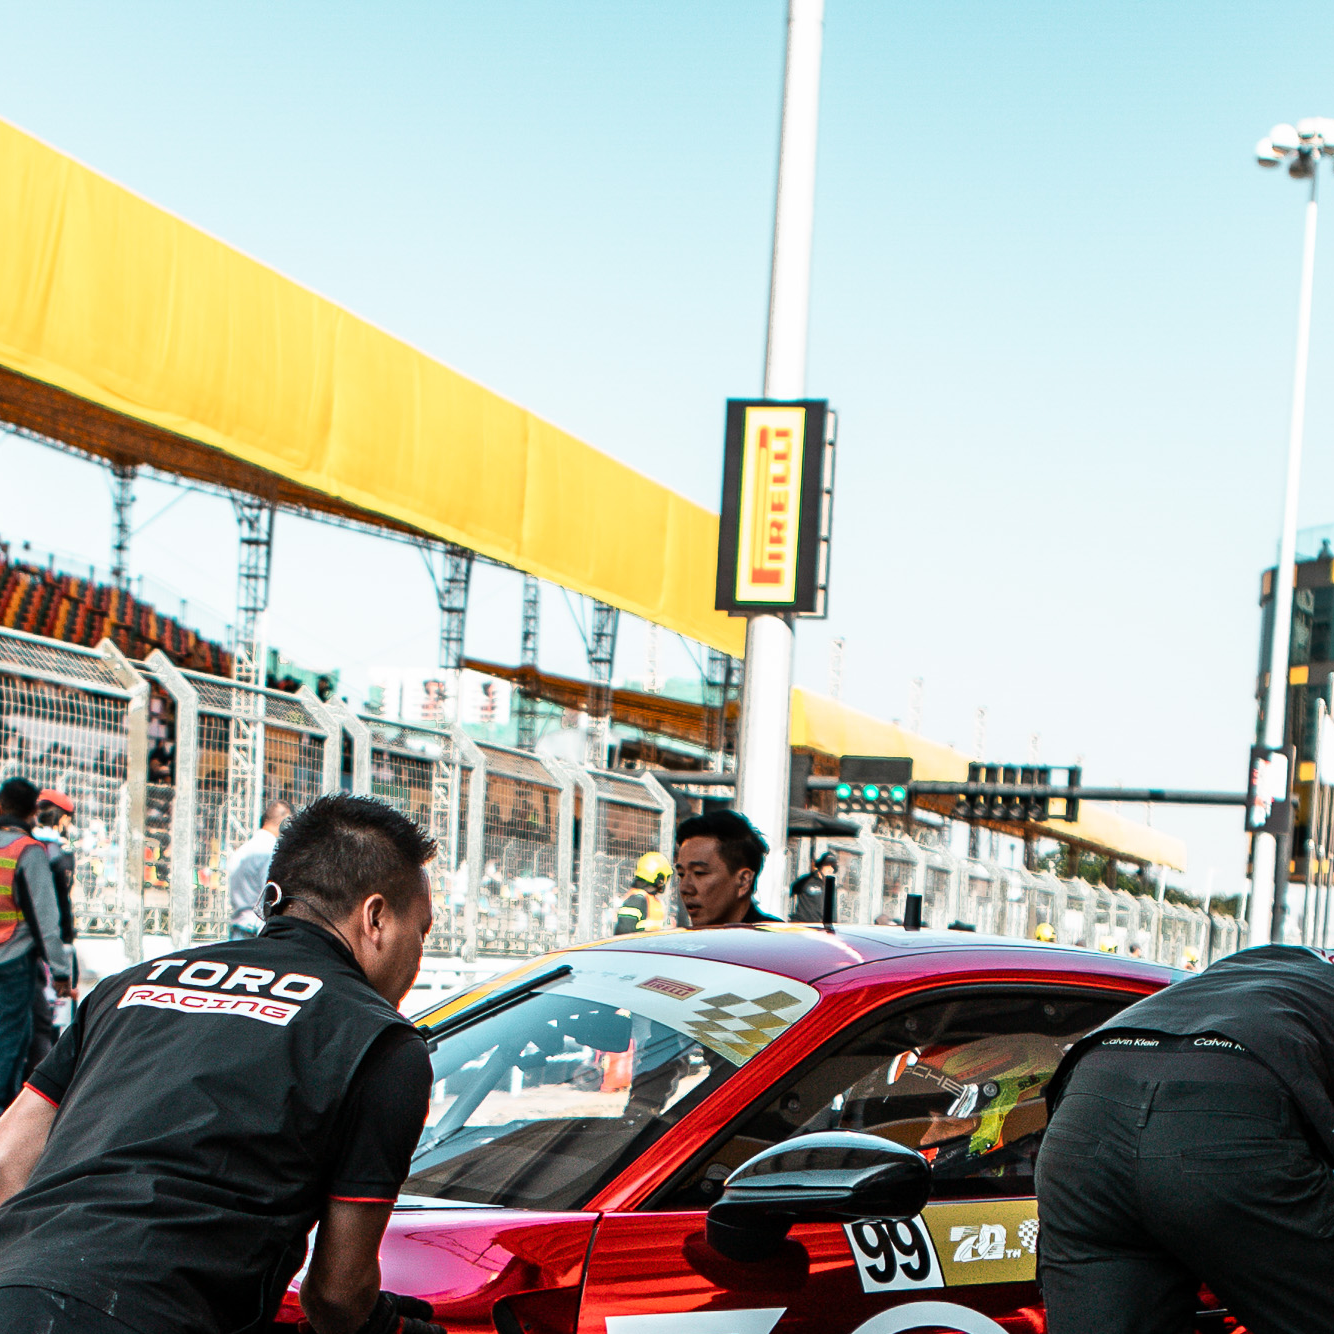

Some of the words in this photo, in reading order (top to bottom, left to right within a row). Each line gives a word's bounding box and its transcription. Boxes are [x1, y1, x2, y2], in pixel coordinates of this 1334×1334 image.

[752, 427, 791, 584] PIRELLI
[146, 958, 324, 1001] TORO
[643, 977, 697, 997] PIRELLI
[126, 988, 292, 1019] RACING
[1101, 1037, 1133, 1046] Calvin
[1133, 1037, 1160, 1047] Klein
[1193, 1037, 1233, 1048] Calvin
[851, 1218, 932, 1284] 99
